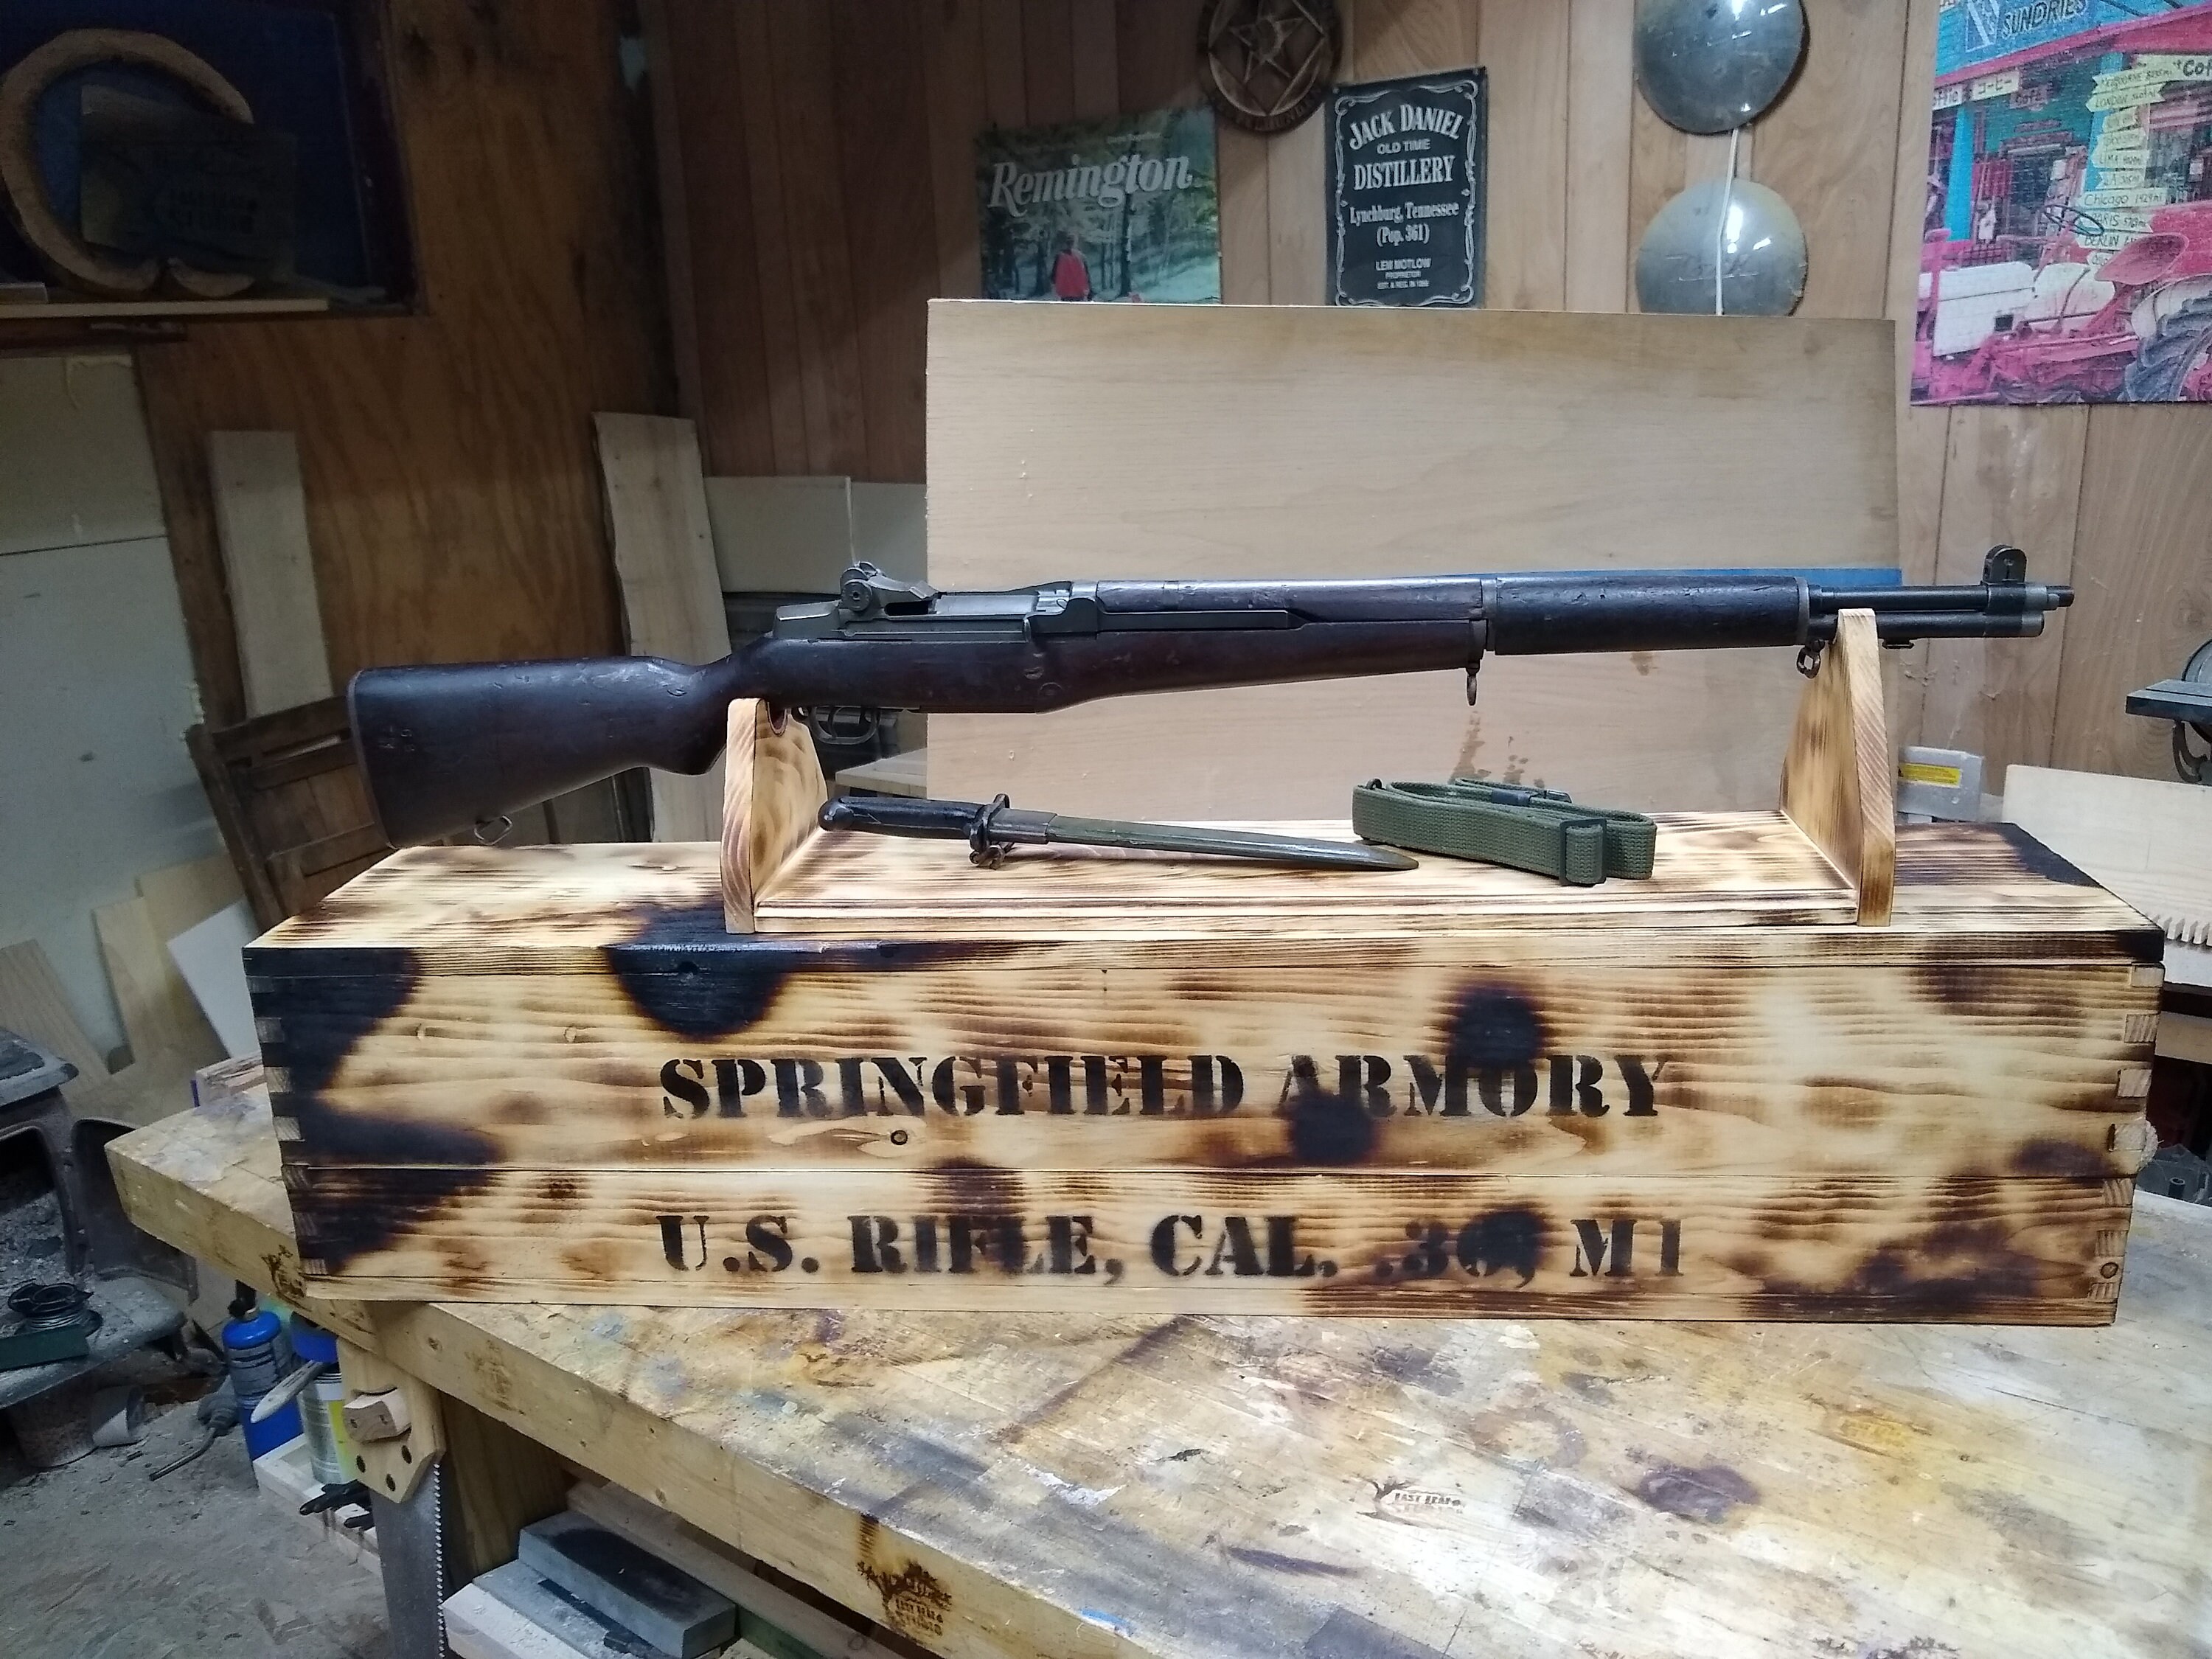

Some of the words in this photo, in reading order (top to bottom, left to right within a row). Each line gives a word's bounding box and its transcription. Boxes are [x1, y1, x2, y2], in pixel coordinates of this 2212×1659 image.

[1349, 111, 1397, 150] JACK
[1399, 103, 1464, 139] DANIEL
[1377, 142, 1401, 155] OLD
[1402, 138, 1431, 152] TIME
[987, 153, 1193, 218] Remington
[1353, 155, 1456, 191] DISTILLERY
[1405, 201, 1460, 220] Tennessee
[2084, 194, 2129, 206] Chicago
[1405, 223, 1430, 244] 361)
[660, 1054, 1244, 1119] SPRINGFIELD
[1278, 1053, 1674, 1119] ARMORY
[656, 1214, 820, 1273] U.S.
[847, 1214, 1125, 1285] RIFLE,
[1150, 1213, 1338, 1278] CAL.
[1569, 1218, 1684, 1278] M1
